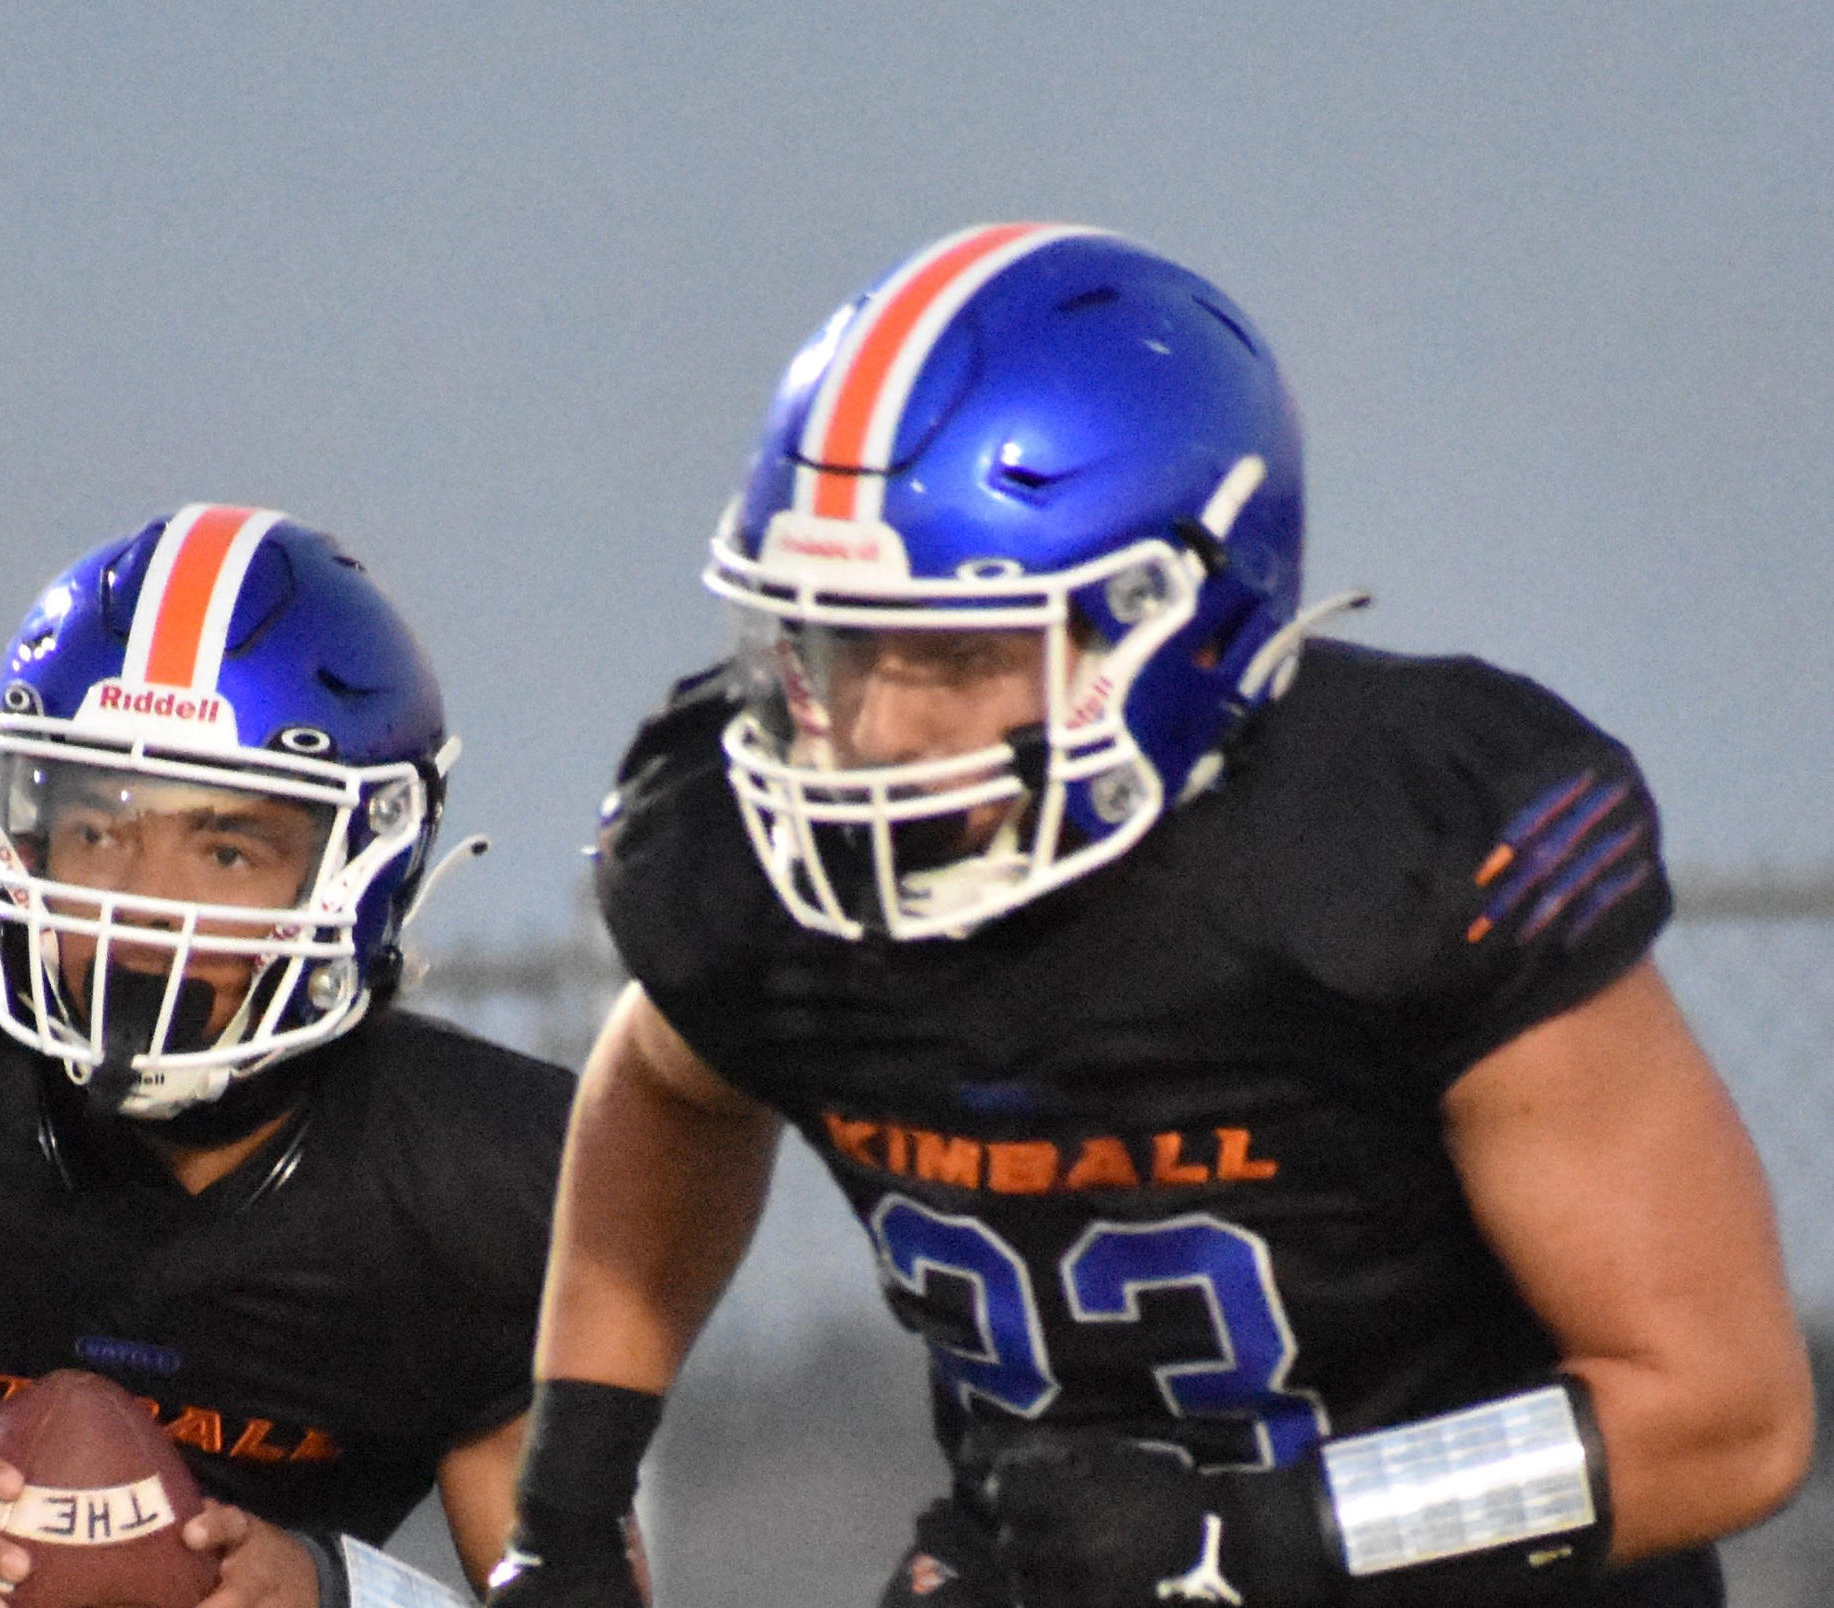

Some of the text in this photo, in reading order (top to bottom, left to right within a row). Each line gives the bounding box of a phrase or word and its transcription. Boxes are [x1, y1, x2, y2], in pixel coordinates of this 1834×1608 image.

[100, 684, 220, 723] Riddell
[820, 1110, 1278, 1195] KIMBALL
[38, 1488, 159, 1538] THE
